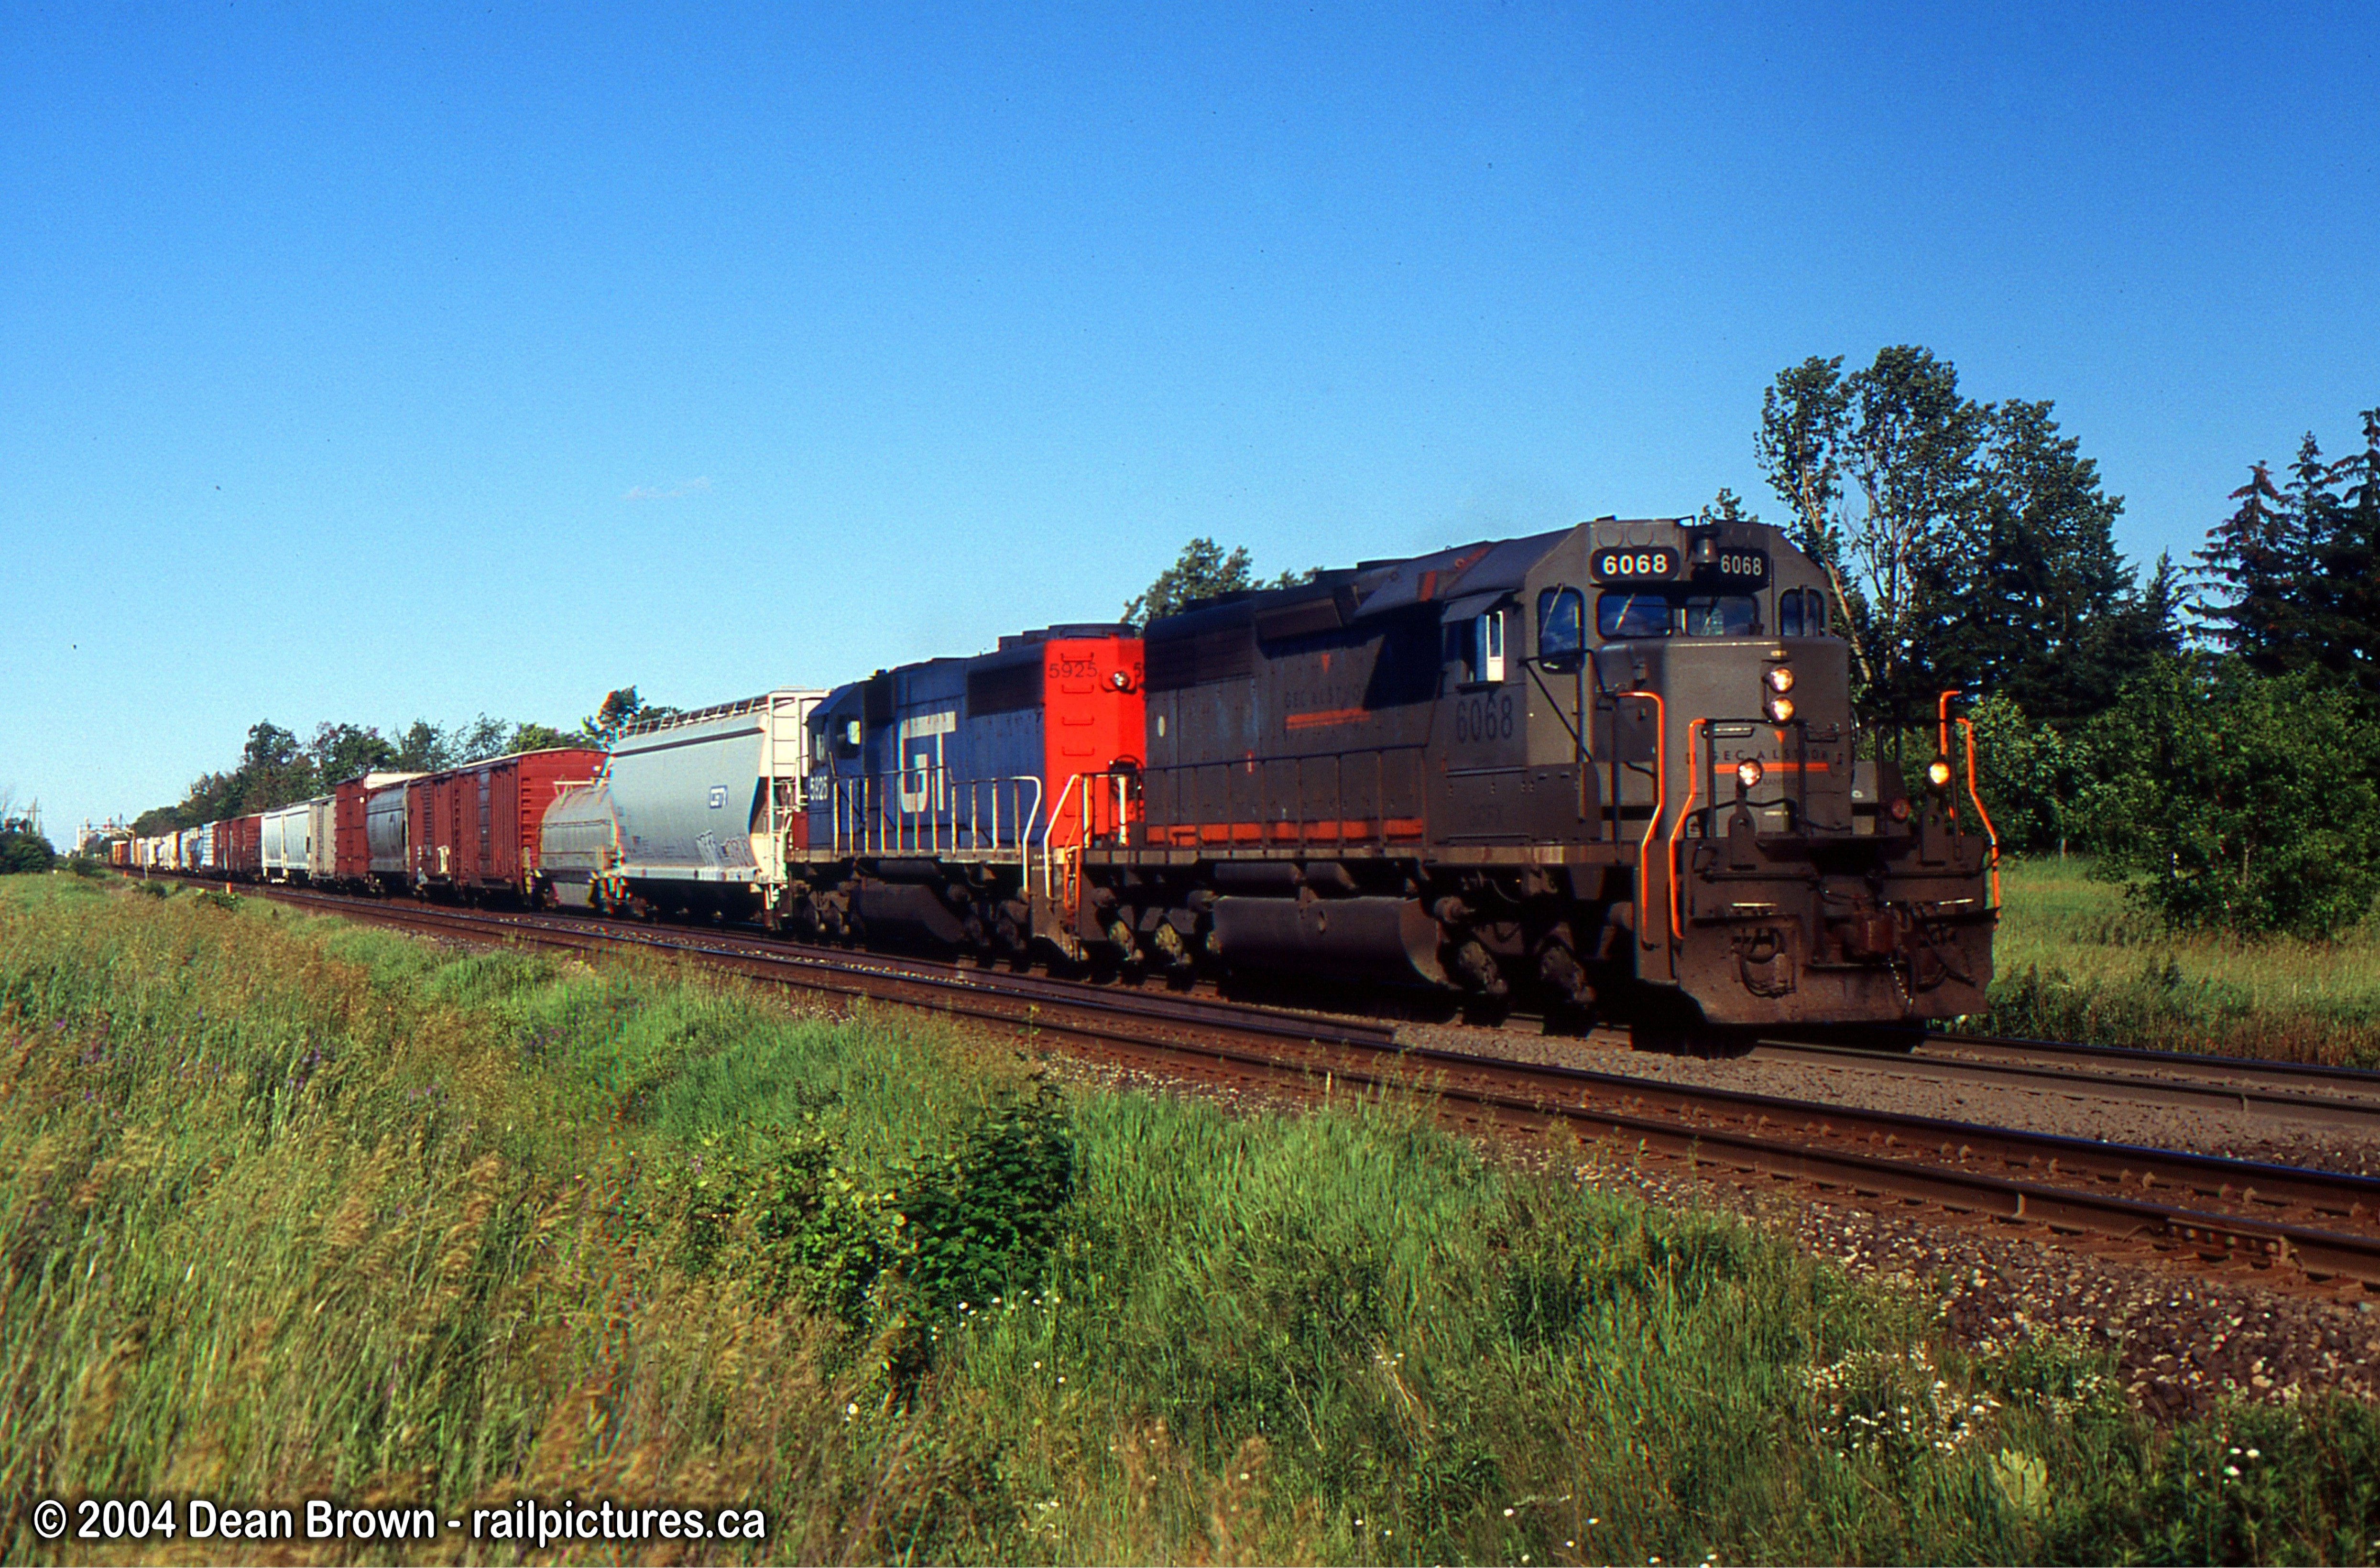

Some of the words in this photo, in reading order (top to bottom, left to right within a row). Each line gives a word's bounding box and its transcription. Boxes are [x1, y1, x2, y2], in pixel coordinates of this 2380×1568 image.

[1602, 554, 1669, 575] 6068
[1721, 555, 1762, 576] 6068
[1048, 662, 1098, 679] 5925
[1456, 695, 1512, 744] 6068
